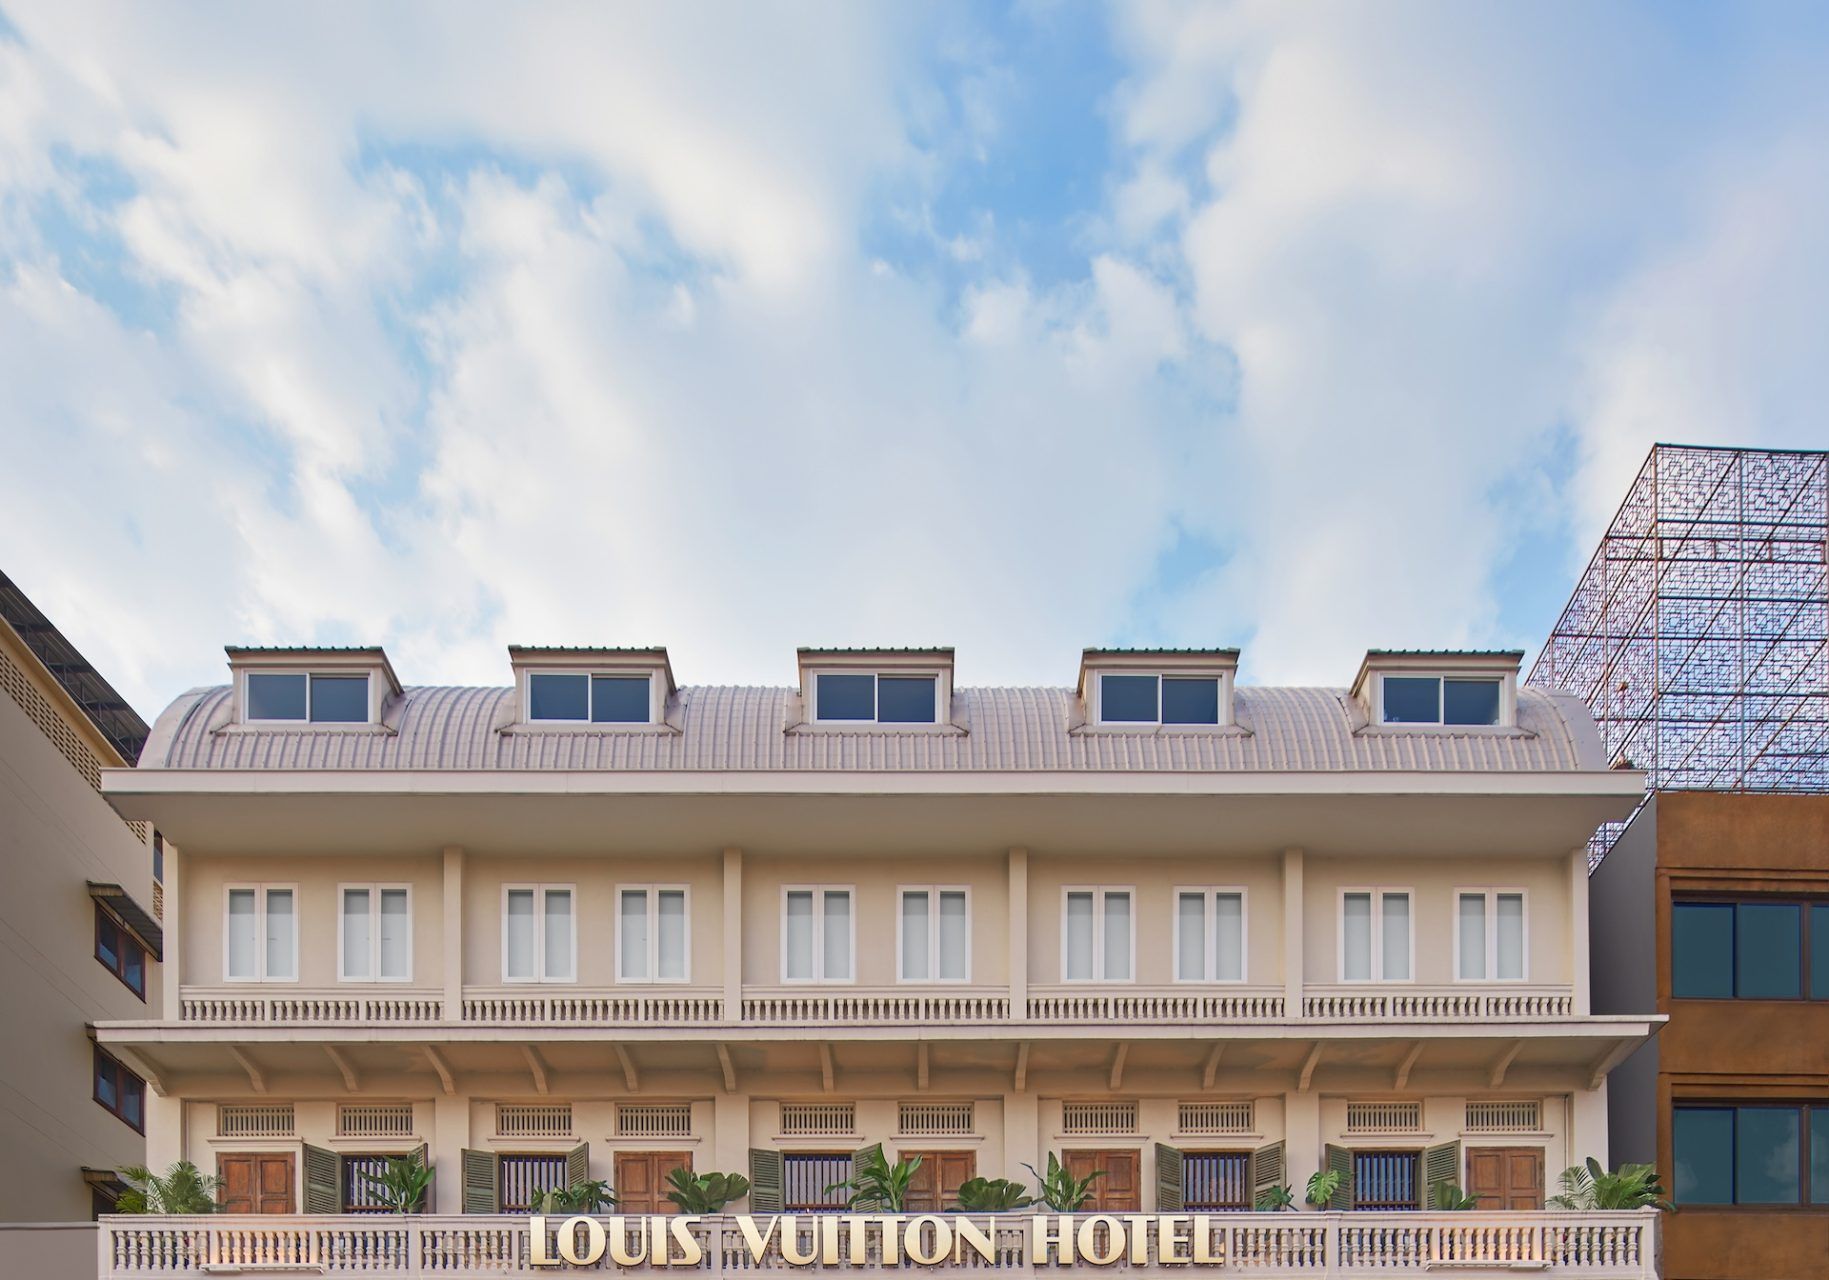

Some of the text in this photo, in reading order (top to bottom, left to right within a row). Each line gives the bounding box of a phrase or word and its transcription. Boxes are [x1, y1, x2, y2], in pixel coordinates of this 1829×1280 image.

[530, 1215, 1225, 1266] LOUIS VUITTON HOTEL
